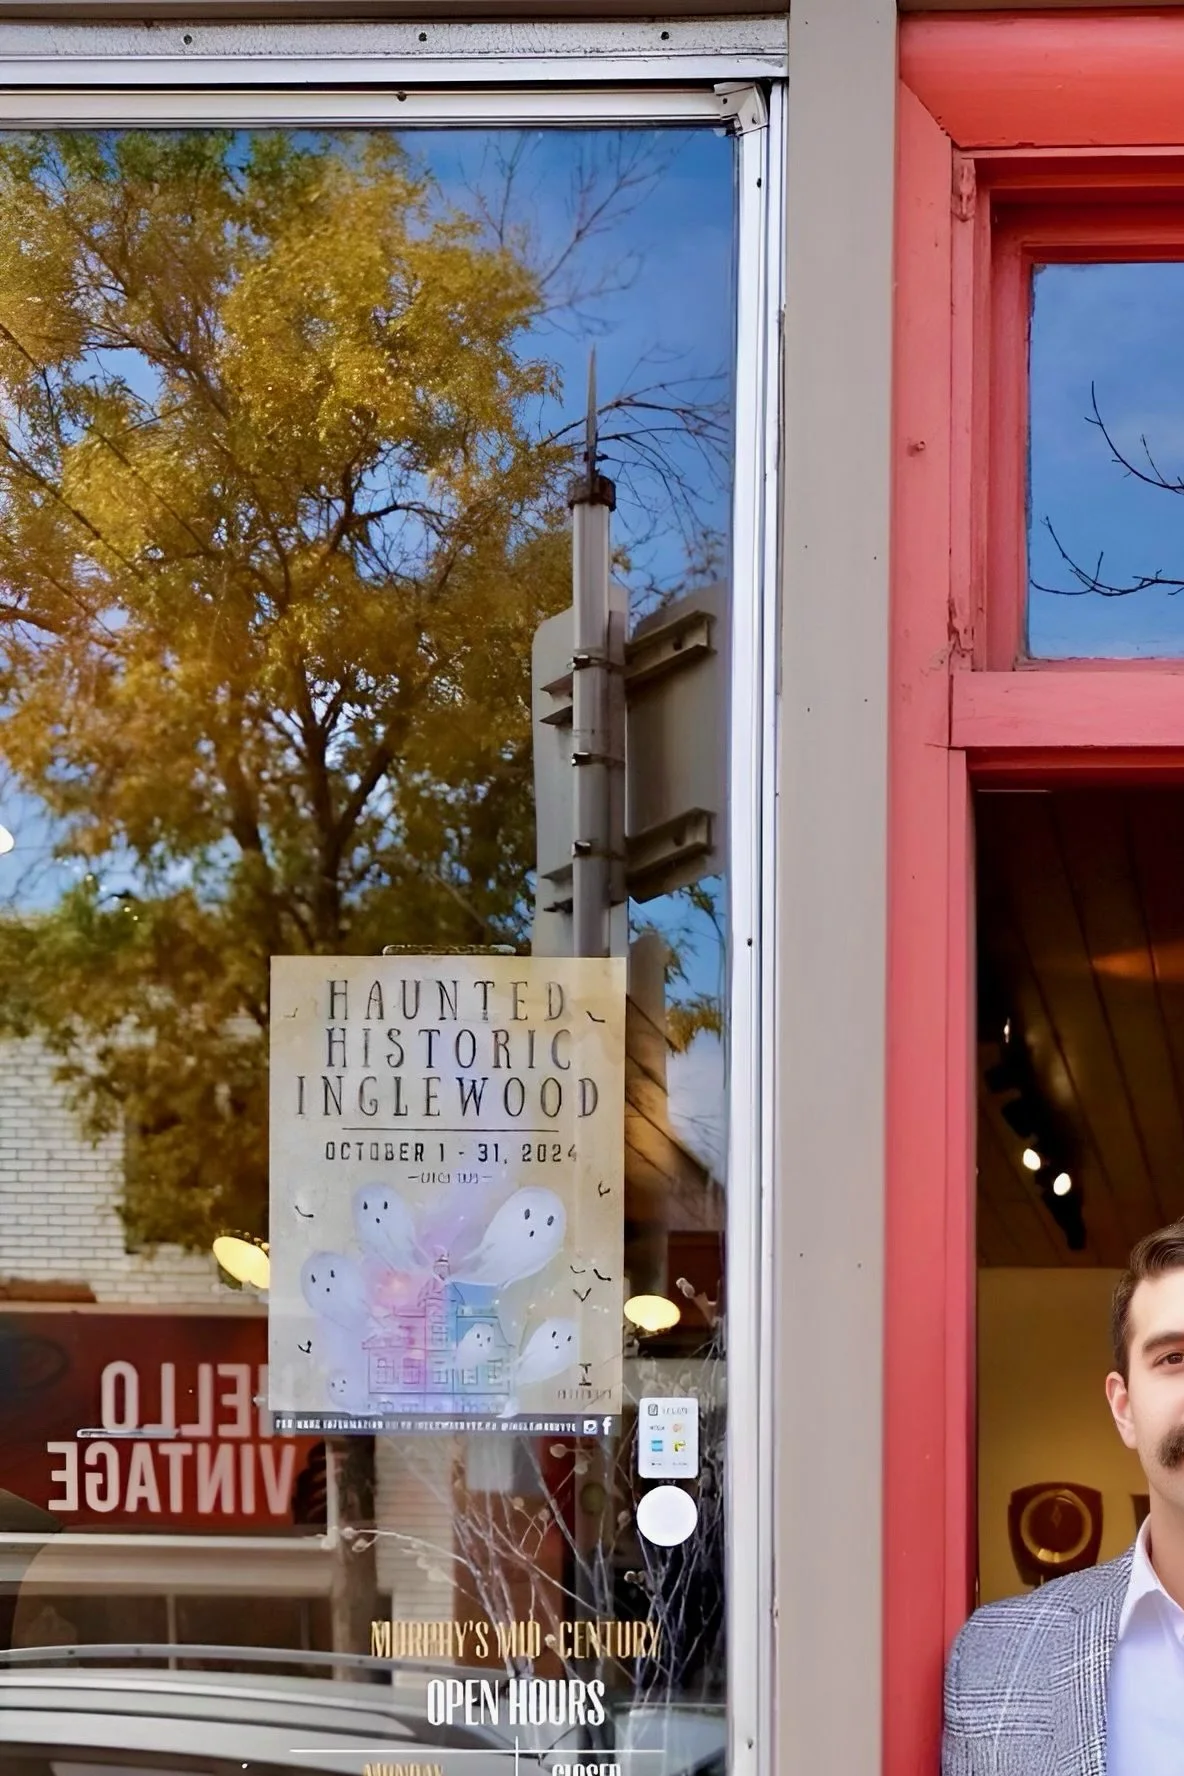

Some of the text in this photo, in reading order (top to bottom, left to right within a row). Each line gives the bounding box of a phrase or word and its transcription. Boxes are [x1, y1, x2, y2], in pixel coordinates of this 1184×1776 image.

[328, 979, 565, 1021] HAUNTED
[326, 1028, 572, 1070] HISTORIC
[295, 1075, 599, 1118] INGLEWOOD
[326, 1142, 424, 1162] OCTOBER
[478, 1143, 508, 1165] 31,
[521, 1143, 577, 1162] 2024
[427, 1679, 605, 1726] OPEN HOURS
